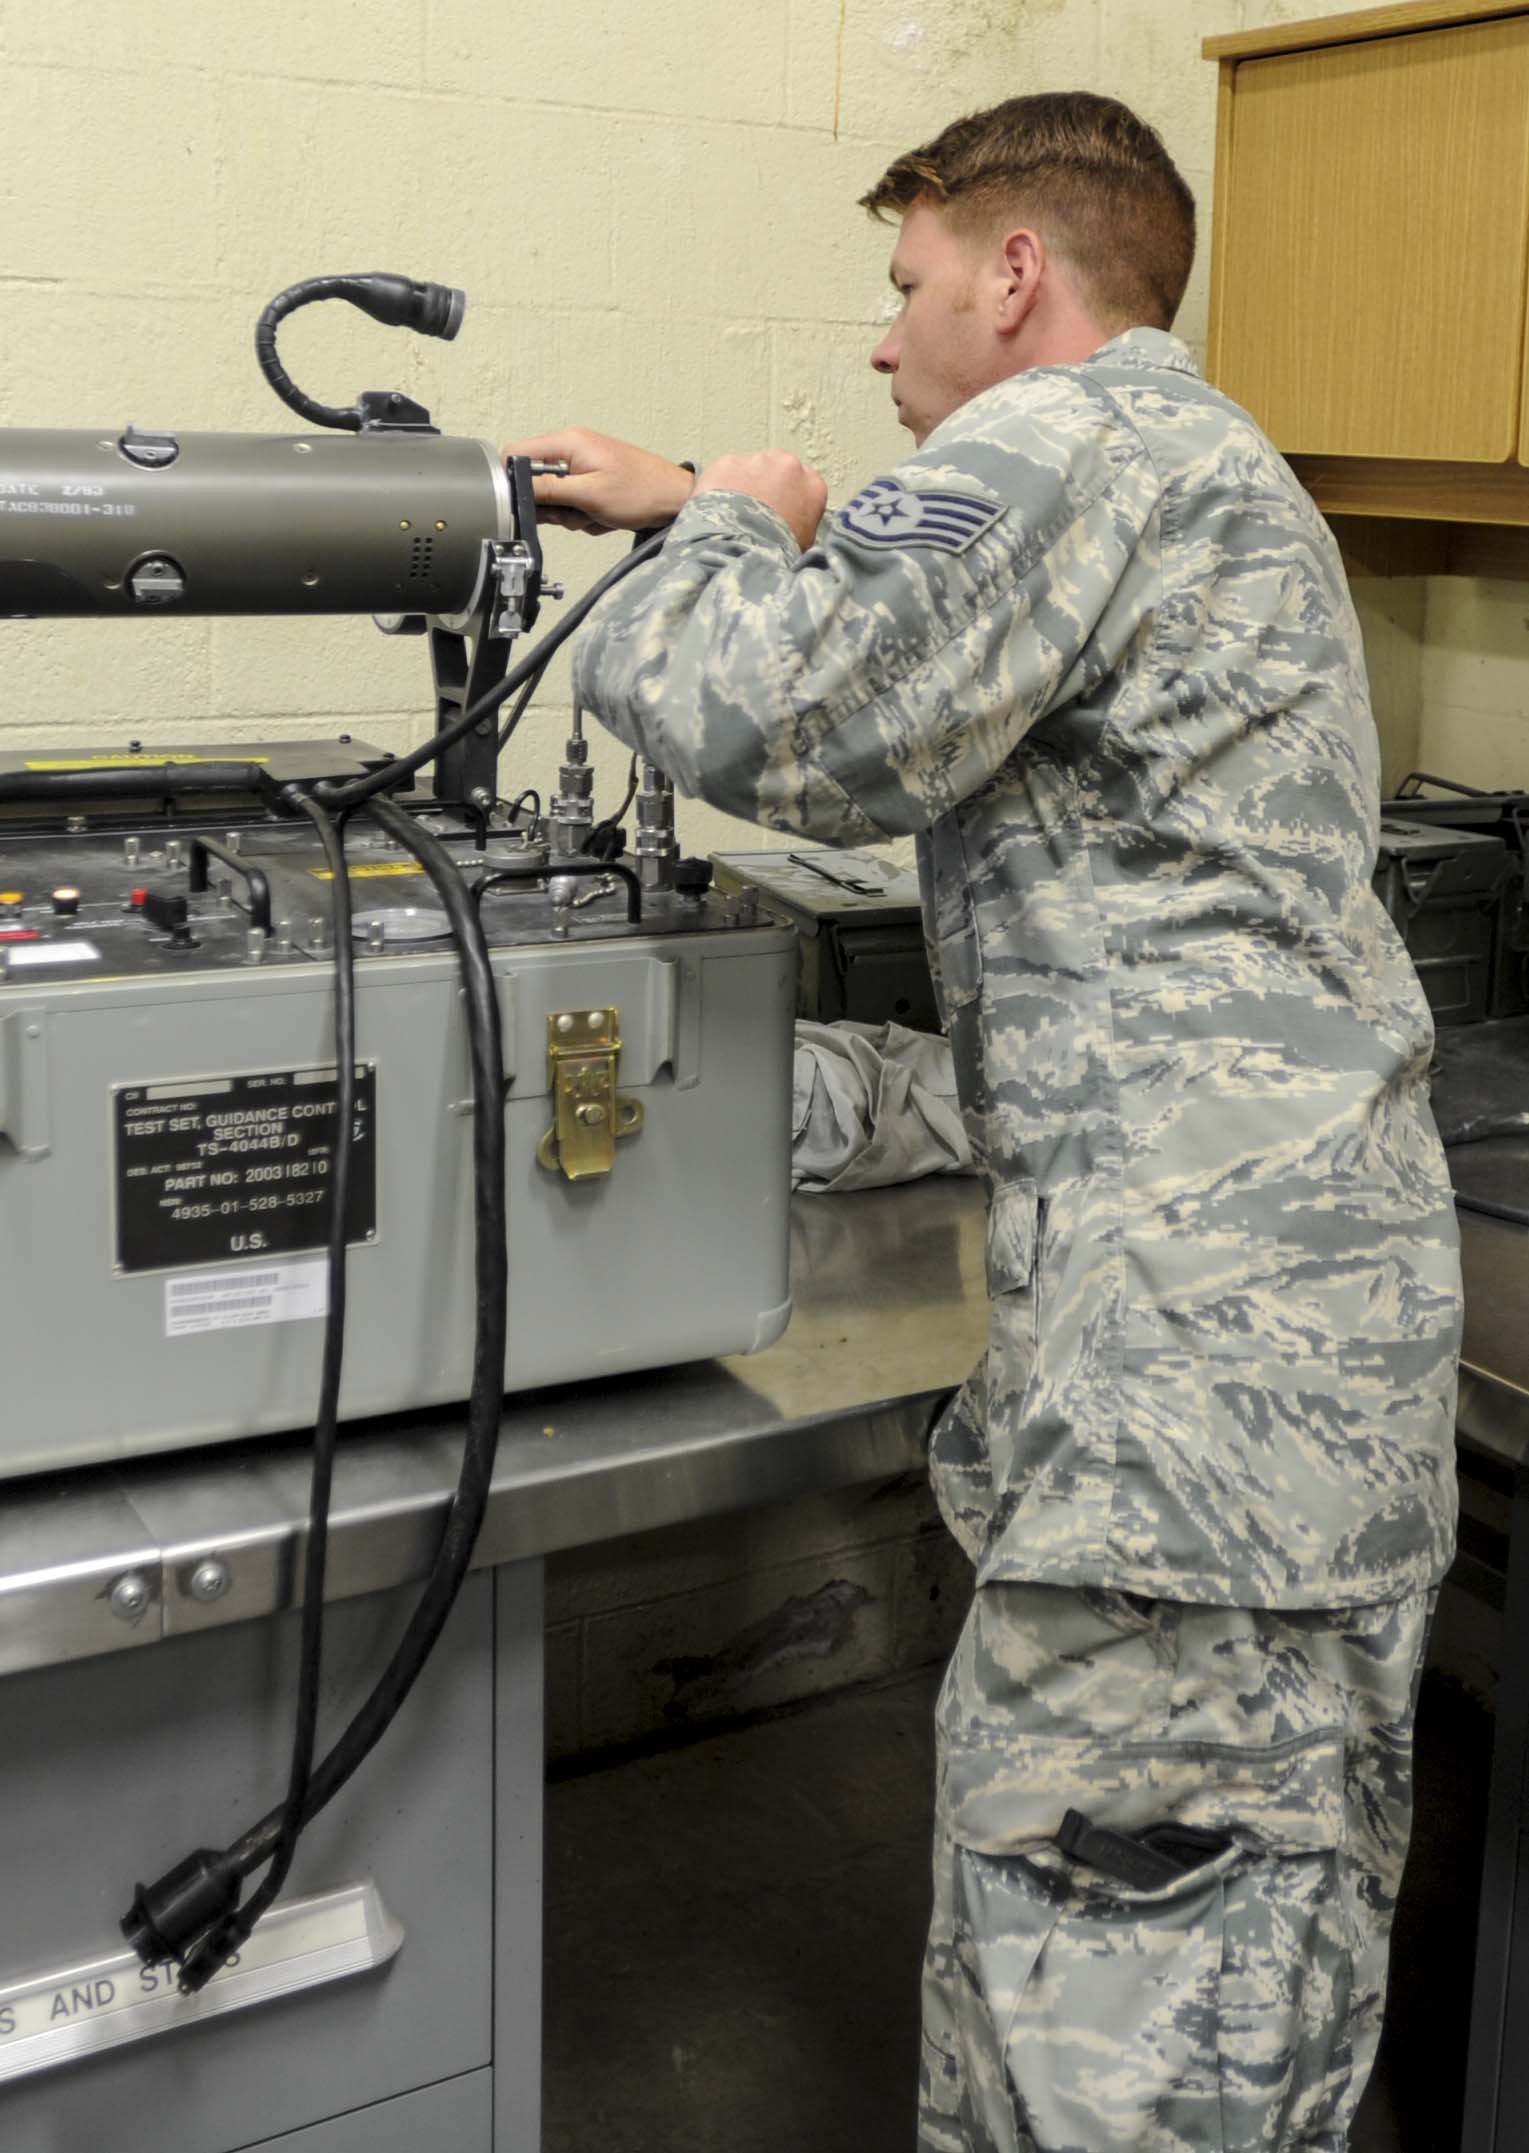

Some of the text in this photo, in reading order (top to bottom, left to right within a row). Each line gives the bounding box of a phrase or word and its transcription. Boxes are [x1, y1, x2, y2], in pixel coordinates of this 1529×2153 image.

[124, 1120, 165, 1136] TEST
[205, 1107, 288, 1129] GUIDANCE
[291, 1099, 368, 1119] CONTL
[213, 1121, 284, 1142] SECTION
[165, 1174, 207, 1192] PART
[210, 1171, 239, 1187] NO:
[171, 1190, 326, 1221] 4935-01-528-5327
[230, 1233, 269, 1252] U.S.
[49, 1979, 117, 2021] AND
